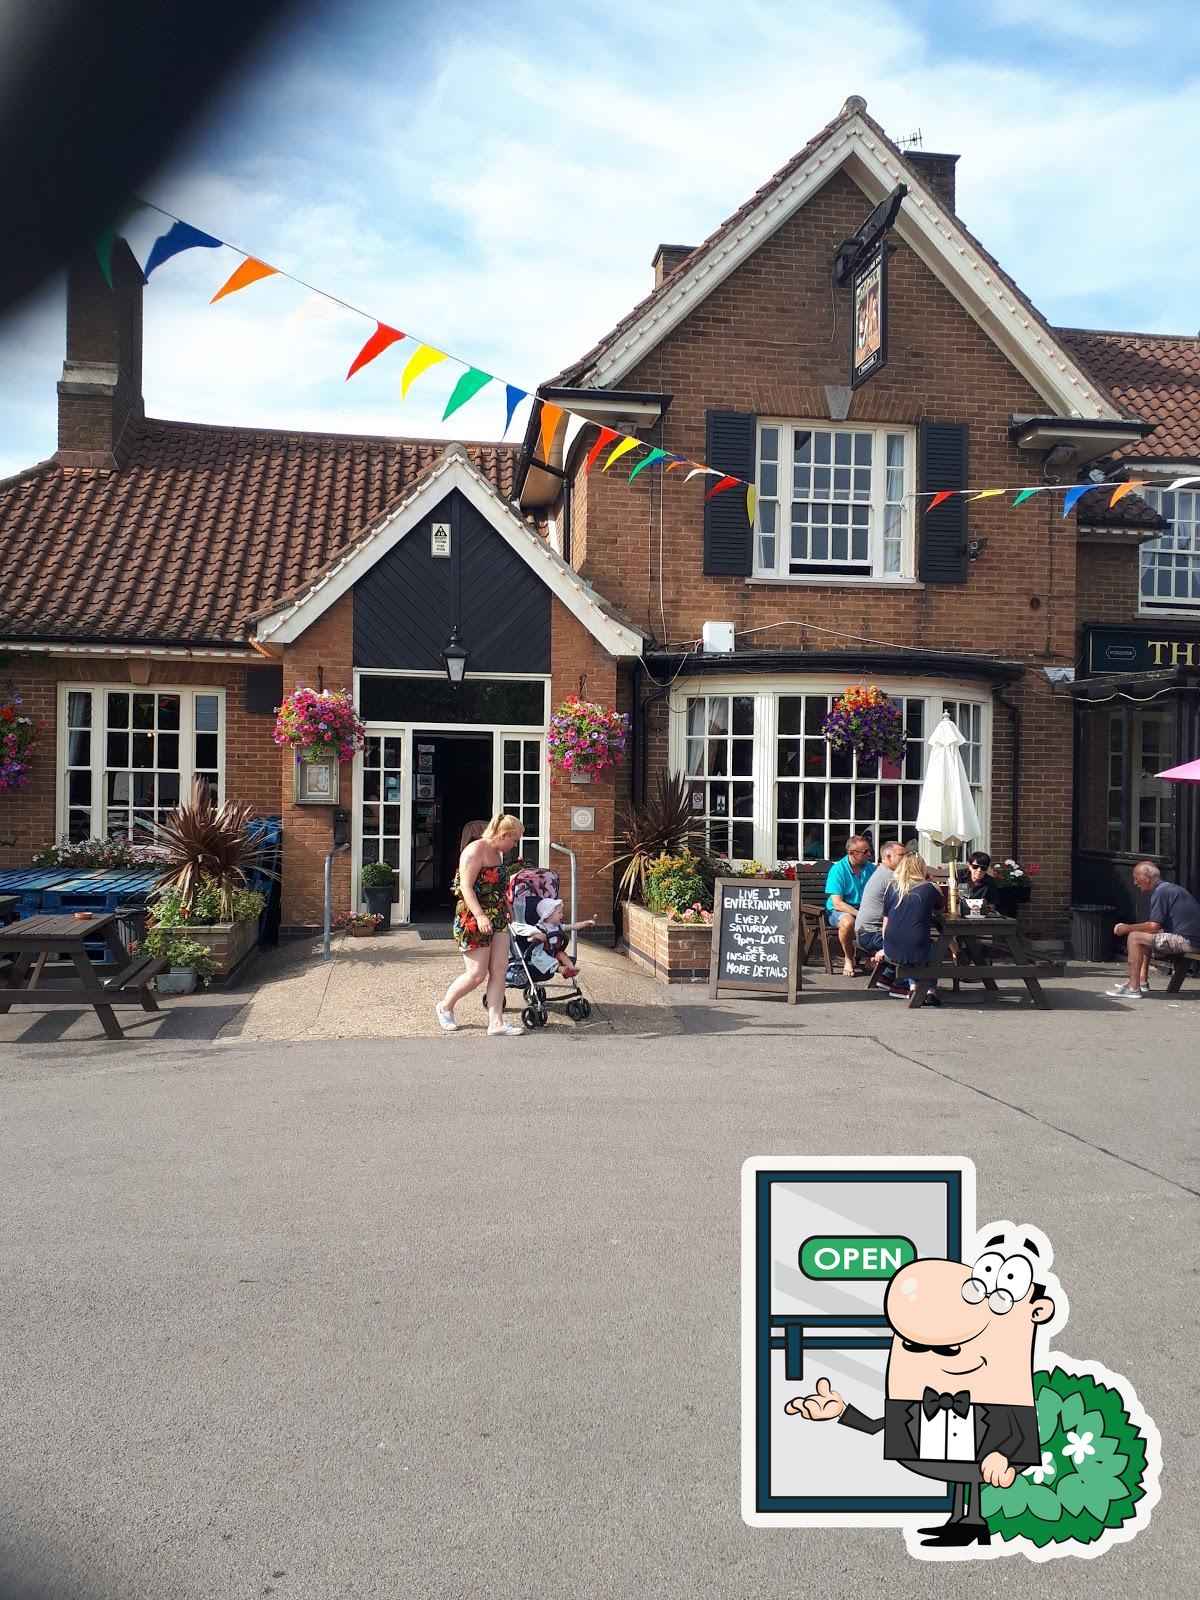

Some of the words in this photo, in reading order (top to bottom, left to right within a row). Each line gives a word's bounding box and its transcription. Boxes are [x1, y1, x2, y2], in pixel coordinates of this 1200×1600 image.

[1148, 640, 1200, 666] TH
[739, 889, 760, 899] LIVE
[724, 897, 791, 911] ENTERTAINMENT
[735, 913, 768, 925] EVERY
[729, 923, 778, 934] SATURDAY
[745, 946, 765, 954] SEE
[726, 951, 757, 962] INSIDE
[760, 953, 780, 962] FOR
[726, 961, 751, 975] MORE
[752, 965, 788, 978] DETAILS
